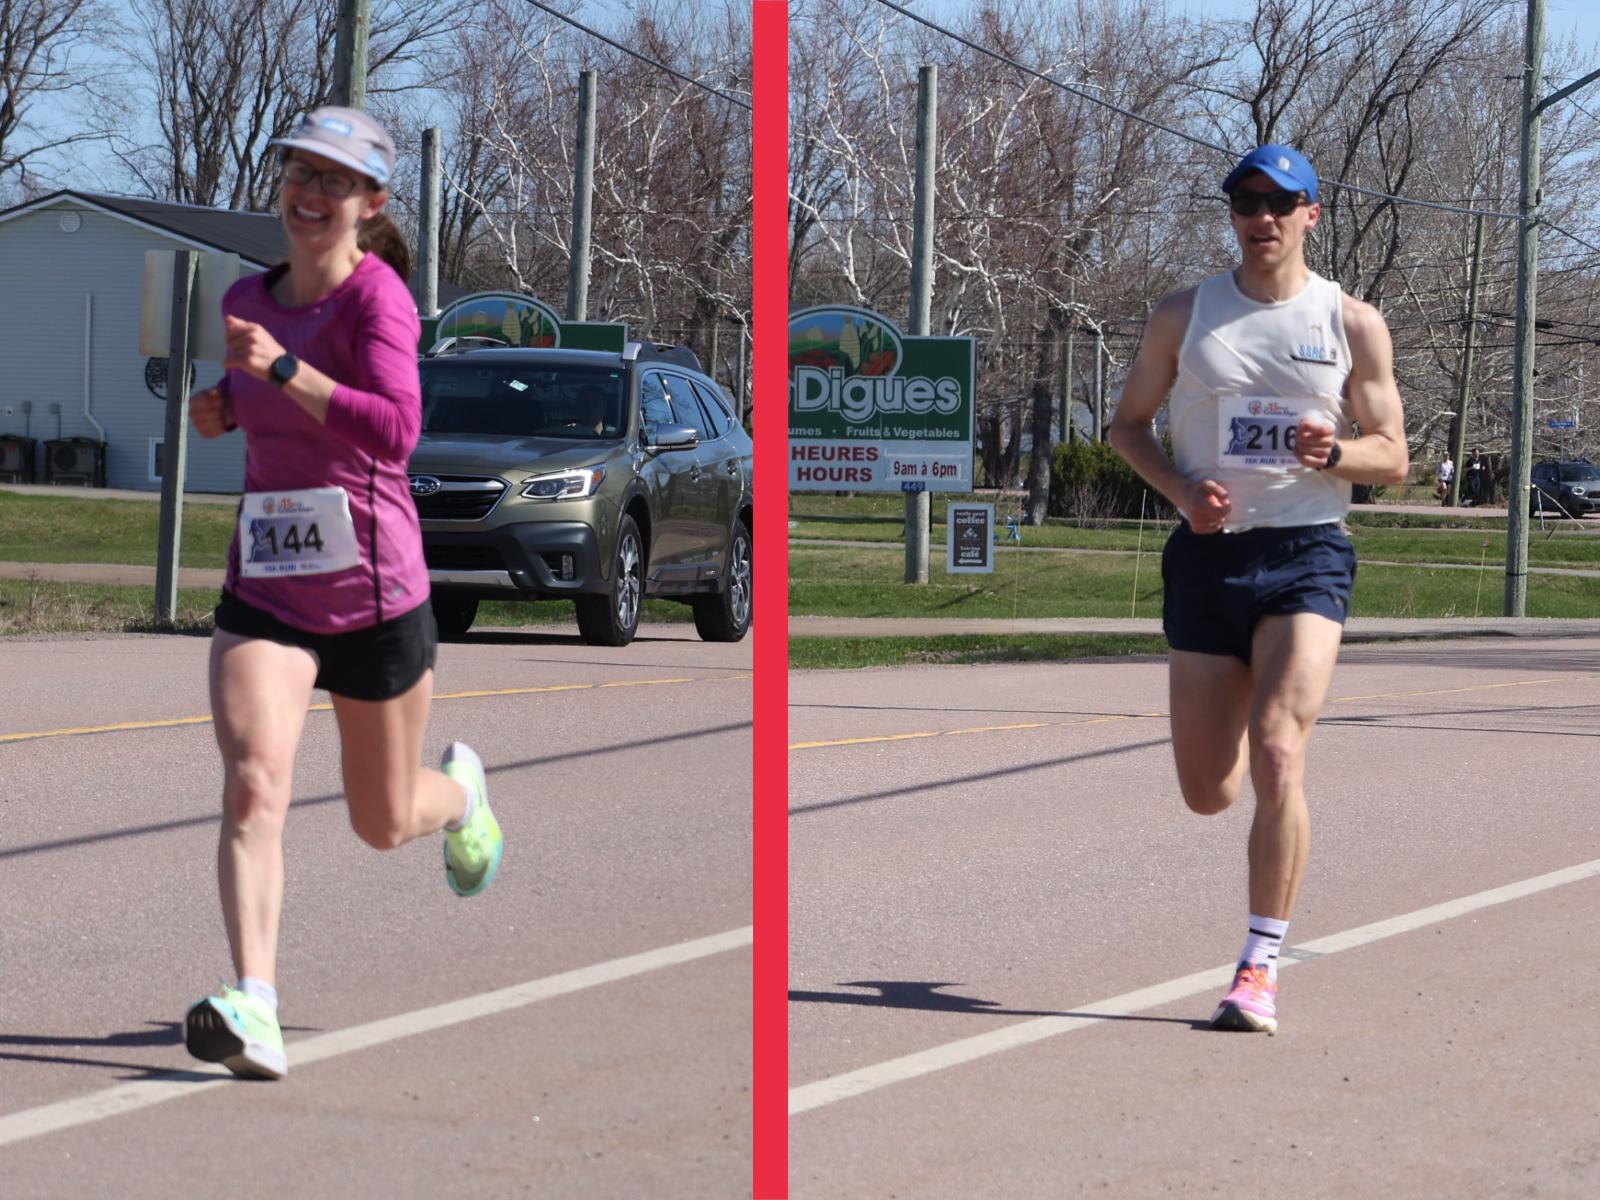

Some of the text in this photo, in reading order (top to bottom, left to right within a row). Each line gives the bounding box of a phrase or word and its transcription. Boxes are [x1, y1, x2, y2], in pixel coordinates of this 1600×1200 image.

[846, 426, 881, 437] Fruits
[883, 427, 891, 438] &
[893, 428, 960, 439] Vegetables
[1246, 425, 1297, 451] 216
[791, 446, 879, 461] HEURES
[797, 467, 873, 482] HOURS
[893, 461, 917, 475] 9am
[932, 461, 957, 478] 6pm
[903, 482, 924, 491] 449
[264, 522, 324, 555] 144
